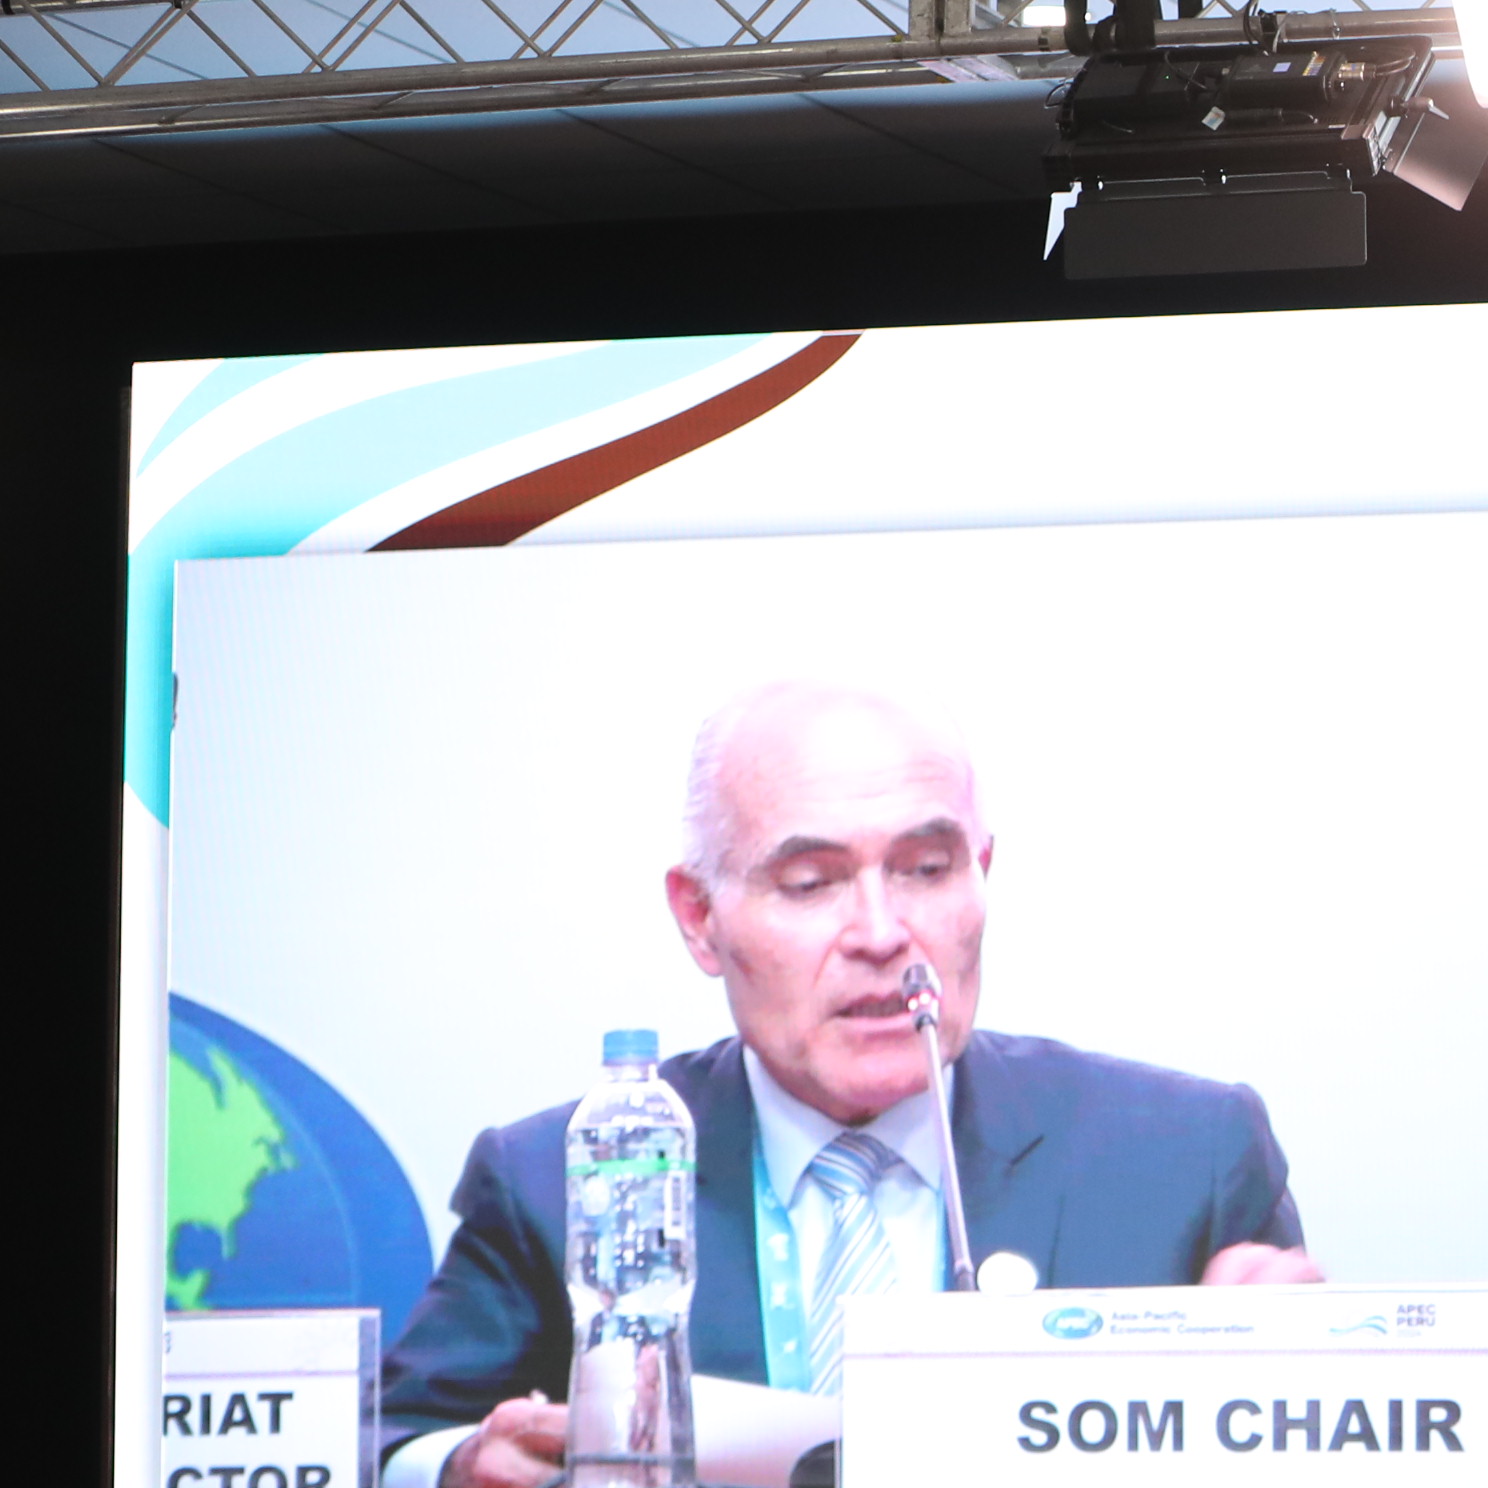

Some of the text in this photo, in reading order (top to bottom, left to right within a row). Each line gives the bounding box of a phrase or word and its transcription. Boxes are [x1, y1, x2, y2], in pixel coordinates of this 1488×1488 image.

[1397, 1304, 1436, 1315] APEC
[1397, 1316, 1435, 1328] PERU
[162, 1392, 294, 1436] RIAT
[1017, 1399, 1464, 1453] SOM CHAIR
